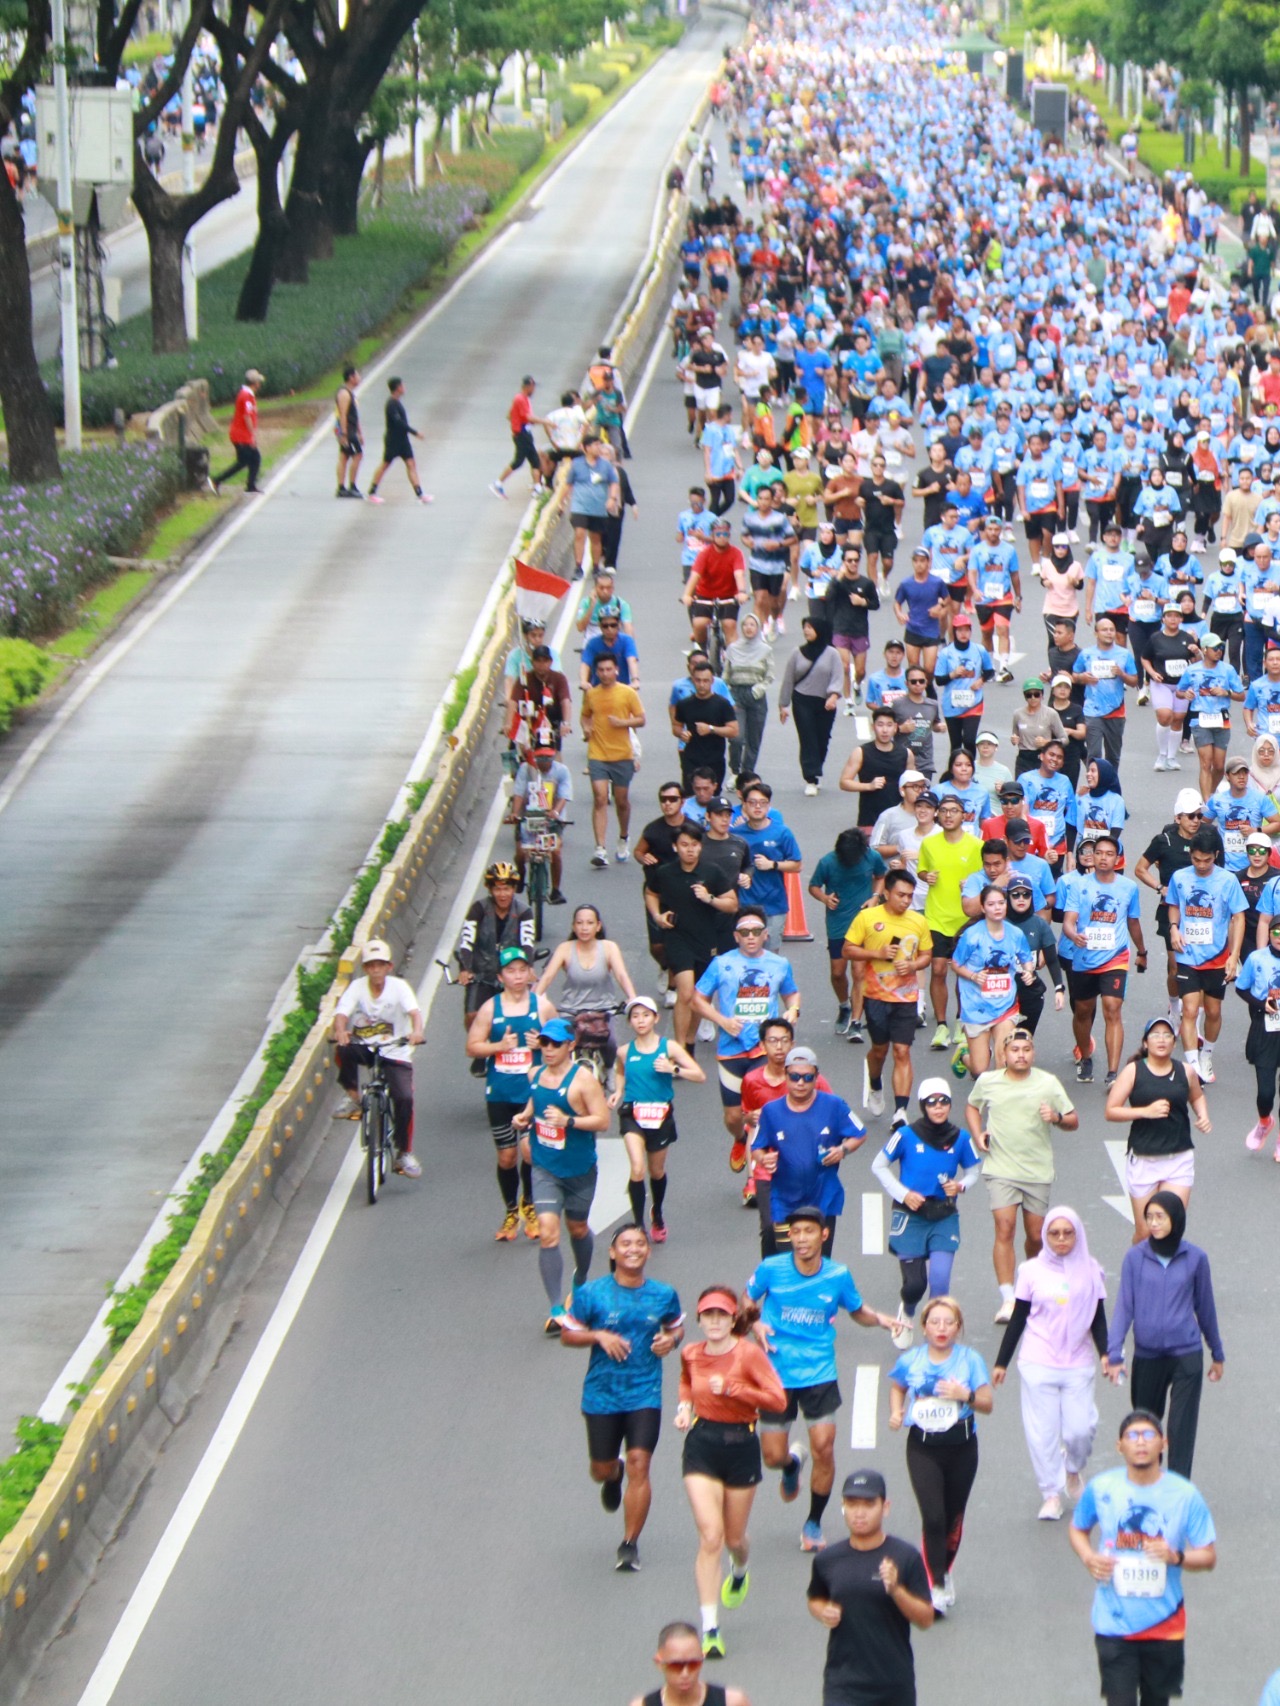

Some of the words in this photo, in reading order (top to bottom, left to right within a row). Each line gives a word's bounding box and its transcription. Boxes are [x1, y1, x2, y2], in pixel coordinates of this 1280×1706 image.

[1185, 927, 1210, 936] 52626
[1088, 933, 1111, 941] 51828
[987, 980, 1008, 989] 10411
[739, 1003, 767, 1013] 15087
[501, 1053, 526, 1063] 11136
[918, 1406, 953, 1419] 51402
[1123, 1568, 1159, 1582] 51319
